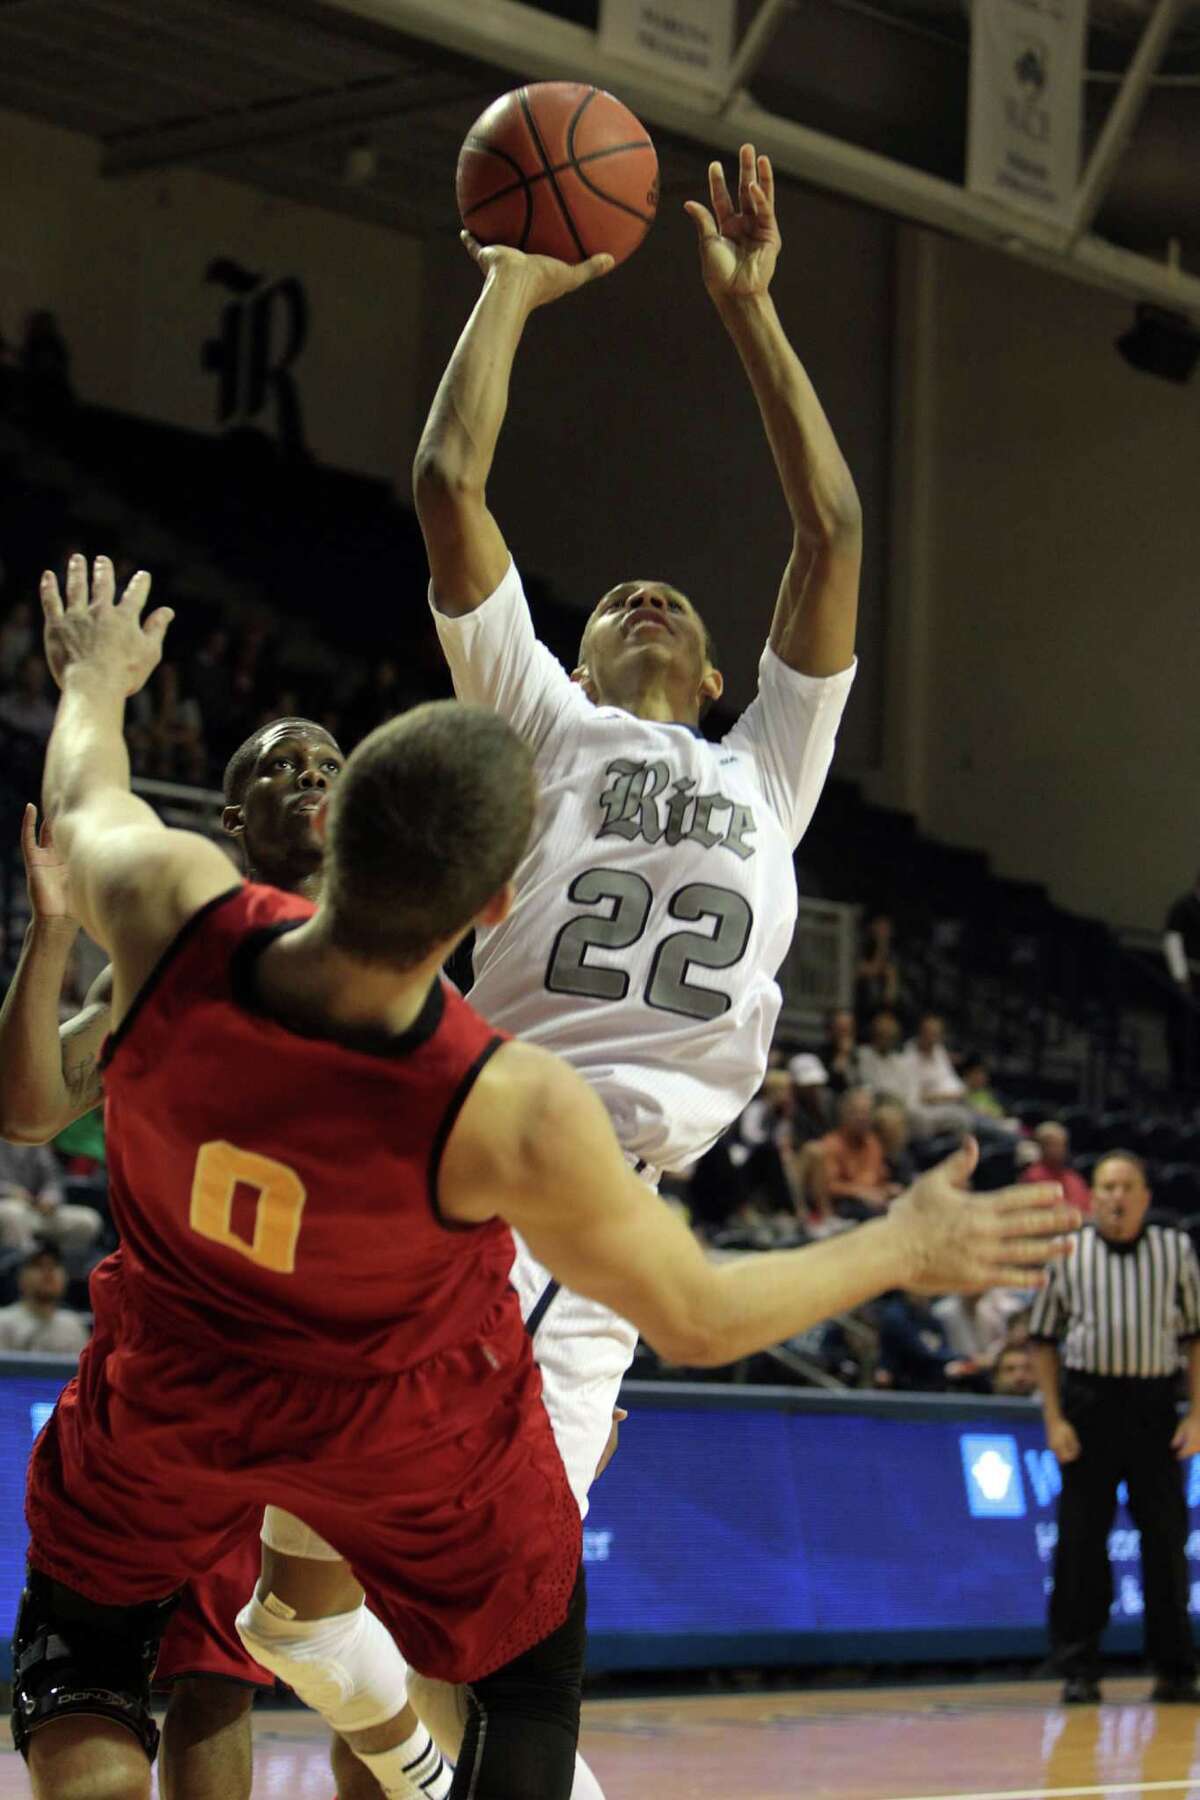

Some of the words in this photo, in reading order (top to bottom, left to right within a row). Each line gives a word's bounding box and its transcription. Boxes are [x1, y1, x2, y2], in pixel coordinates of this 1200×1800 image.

[203, 258, 309, 446] R
[595, 758, 757, 860] Rice
[544, 867, 753, 1021] 22
[189, 1139, 307, 1274] 0
